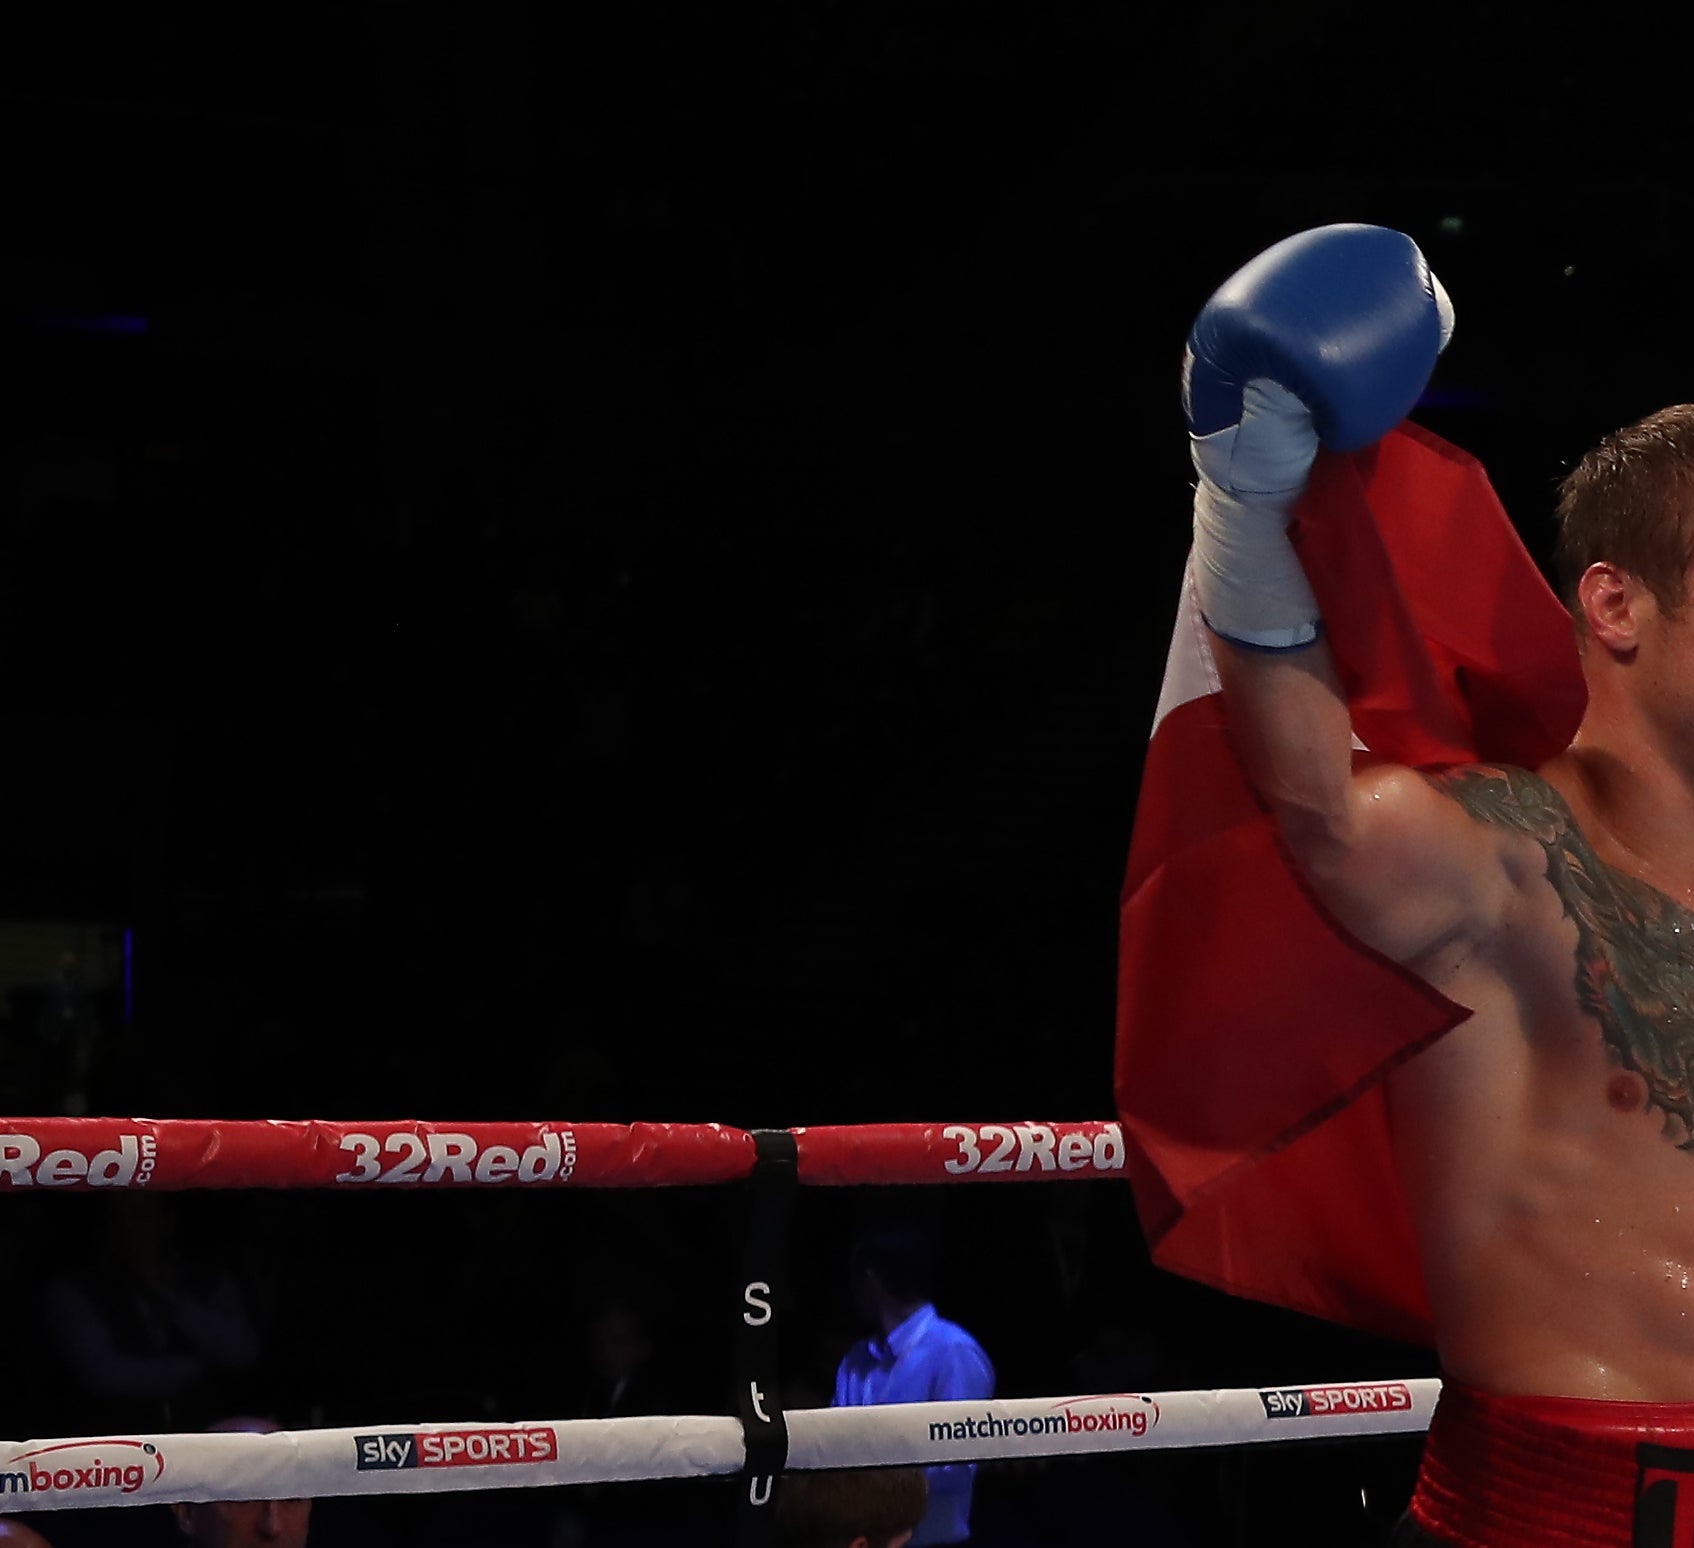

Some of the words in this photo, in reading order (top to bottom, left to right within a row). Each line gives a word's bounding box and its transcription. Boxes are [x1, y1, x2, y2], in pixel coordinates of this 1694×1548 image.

[942, 1122, 1126, 1174] 32Red
[1266, 1392, 1303, 1417] sky
[1312, 1386, 1407, 1412] SPORTS
[363, 1436, 414, 1467] sky
[422, 1429, 553, 1464] SPORTS
